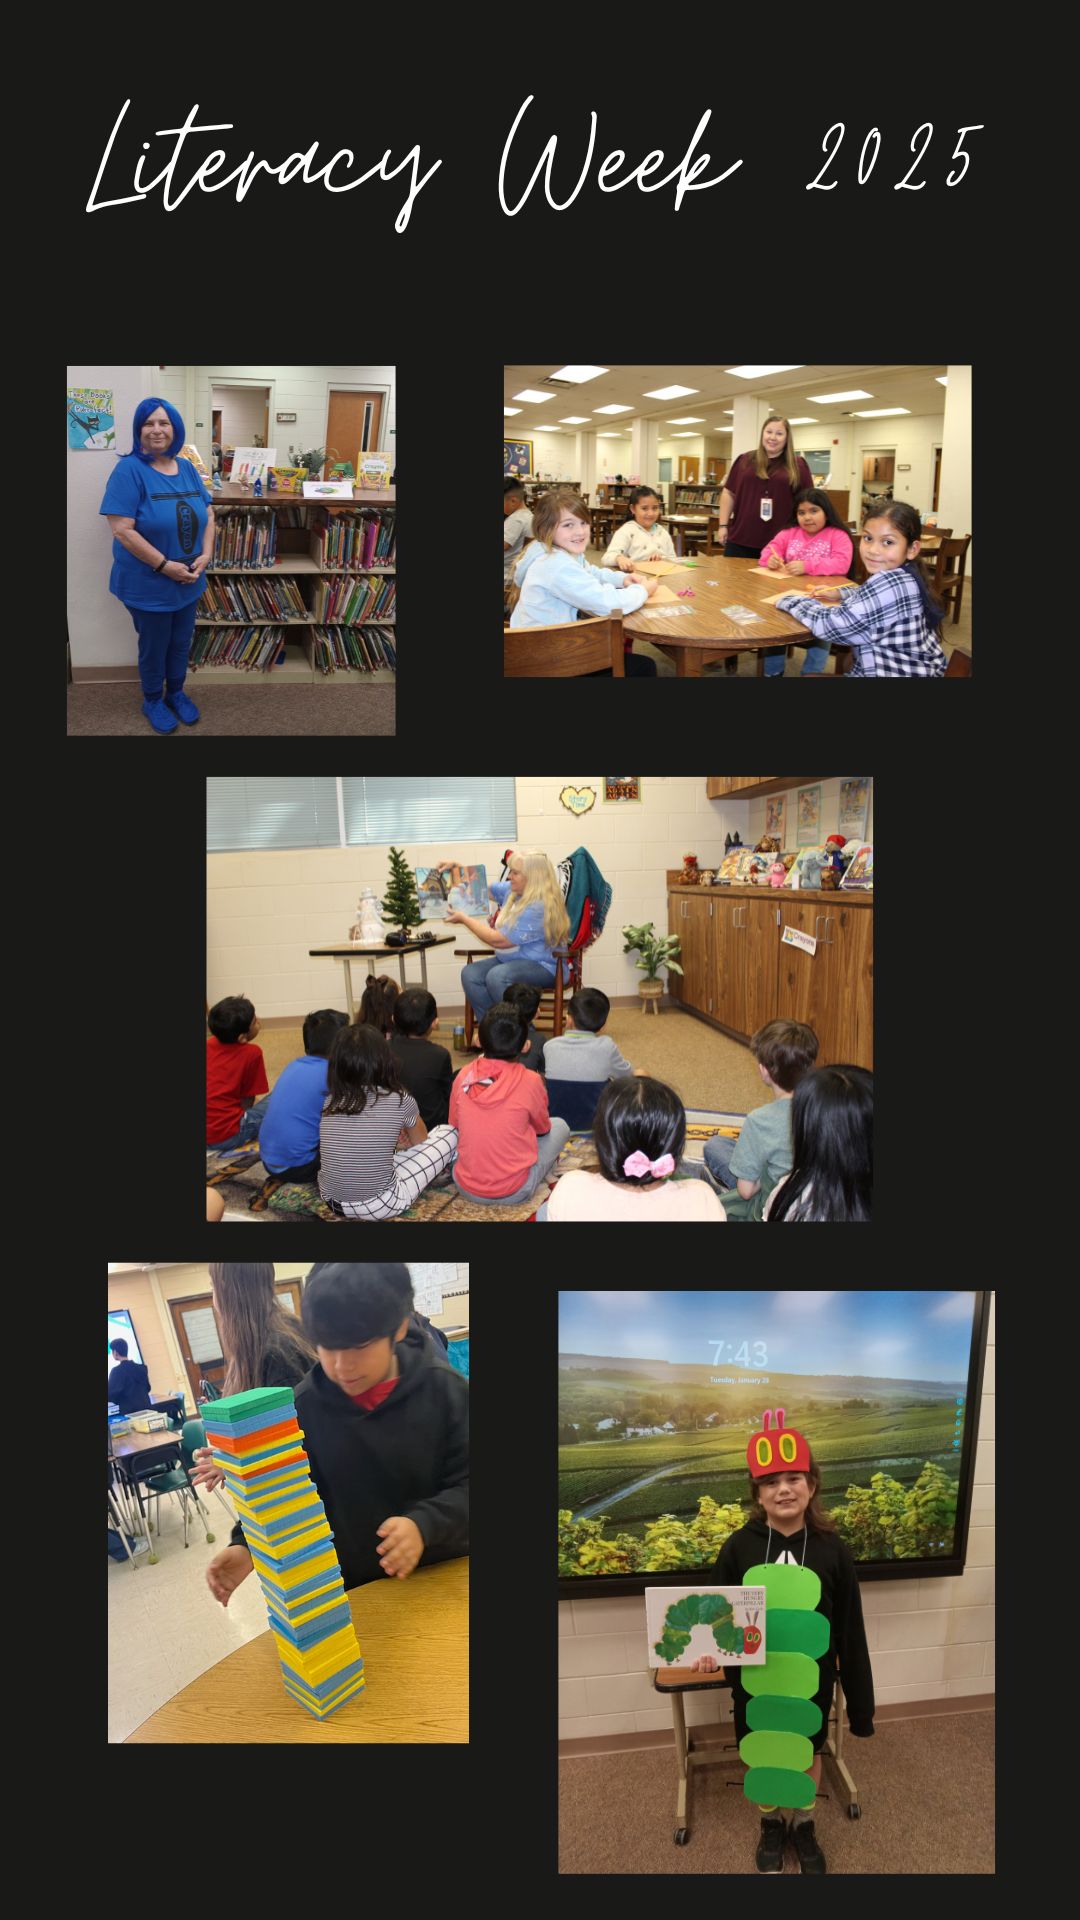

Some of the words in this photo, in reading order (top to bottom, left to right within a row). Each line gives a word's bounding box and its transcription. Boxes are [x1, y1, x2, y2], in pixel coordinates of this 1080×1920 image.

[708, 1340, 768, 1368] 7:43
[710, 1376, 737, 1385] Tuesday,
[738, 1377, 760, 1385] January
